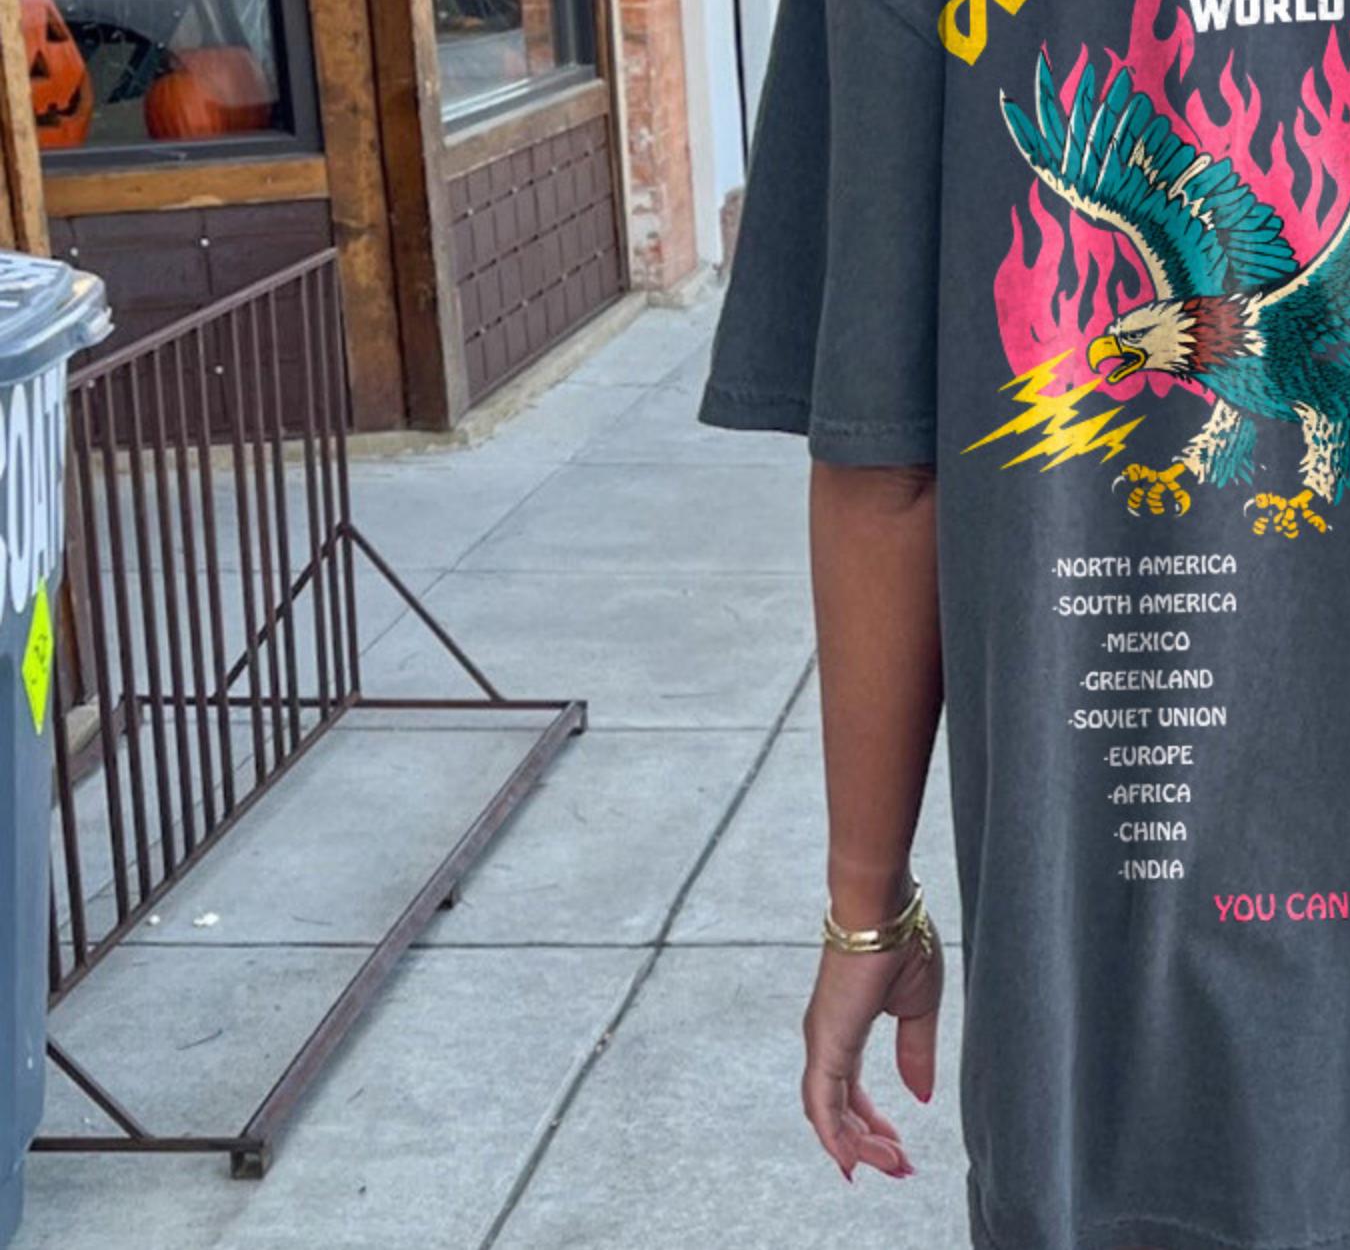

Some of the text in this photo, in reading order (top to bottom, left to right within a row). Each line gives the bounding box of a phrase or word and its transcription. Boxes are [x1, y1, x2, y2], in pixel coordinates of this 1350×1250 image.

[1138, 554, 1237, 576] AMERICA
[1139, 592, 1237, 614] AMERICA
[1158, 706, 1227, 727] UNION
[1214, 894, 1276, 922] YOU
